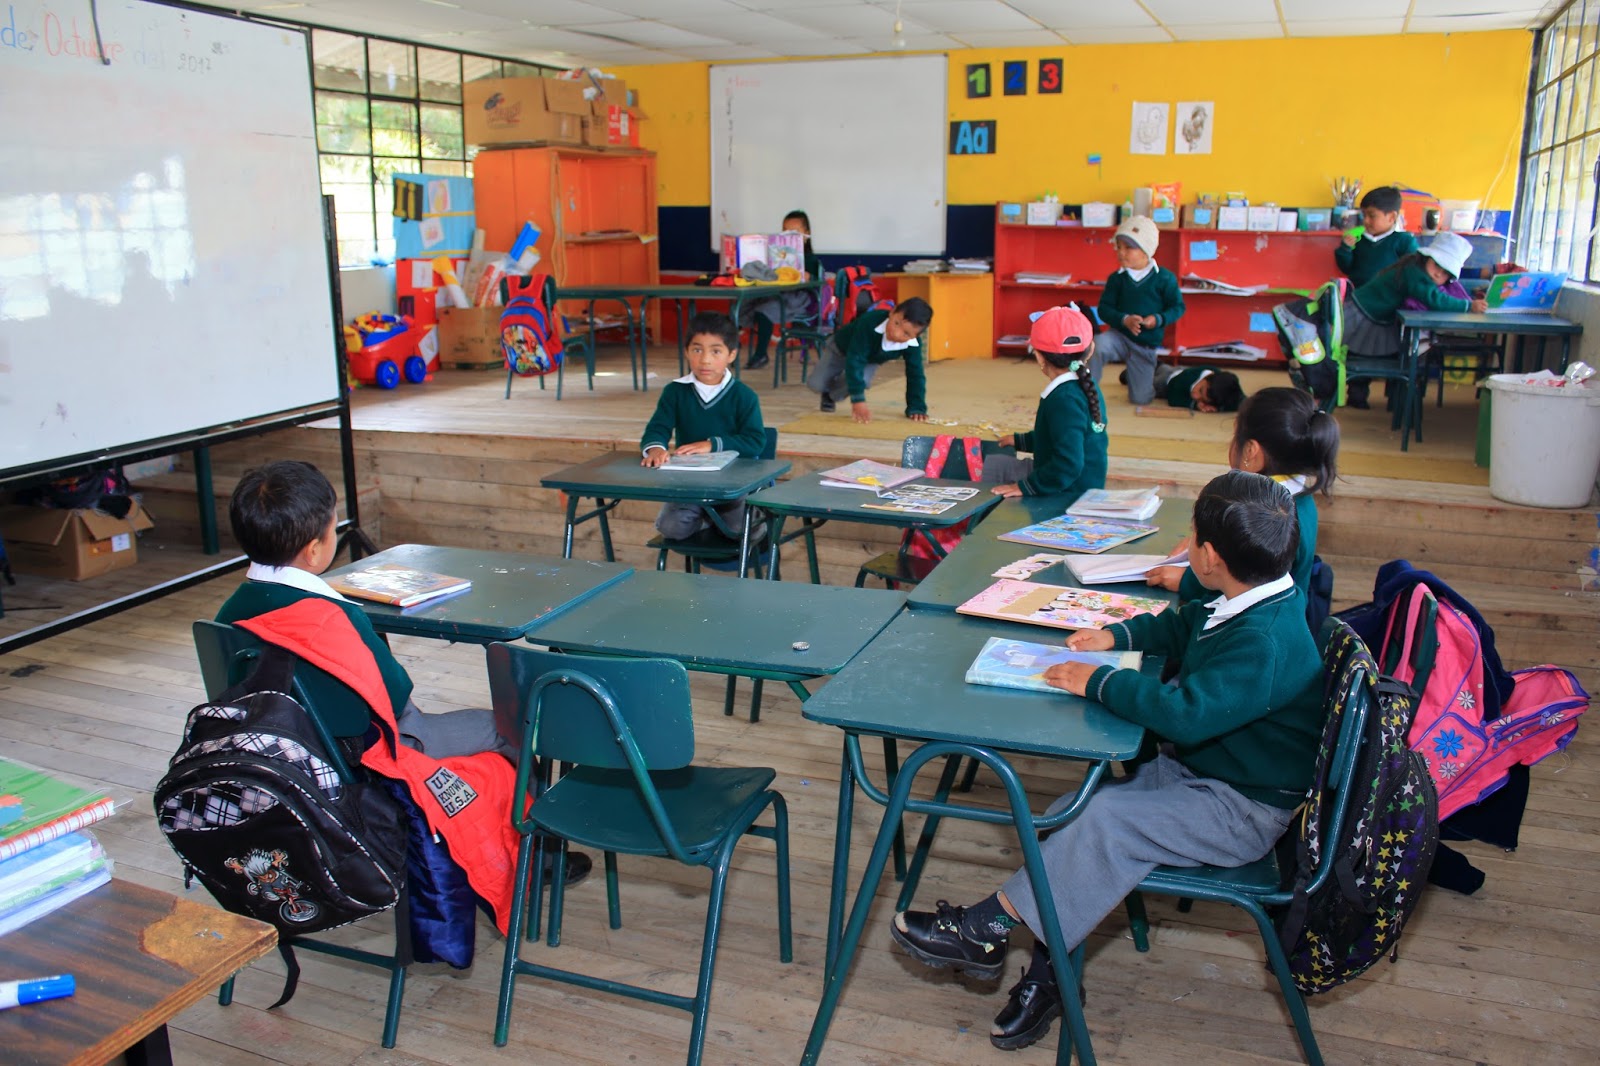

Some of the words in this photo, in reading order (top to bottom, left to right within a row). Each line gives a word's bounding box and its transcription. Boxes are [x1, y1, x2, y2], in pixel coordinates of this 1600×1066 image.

[968, 67, 987, 94] 1
[1007, 63, 1025, 89] 2
[1041, 62, 1060, 90] 3
